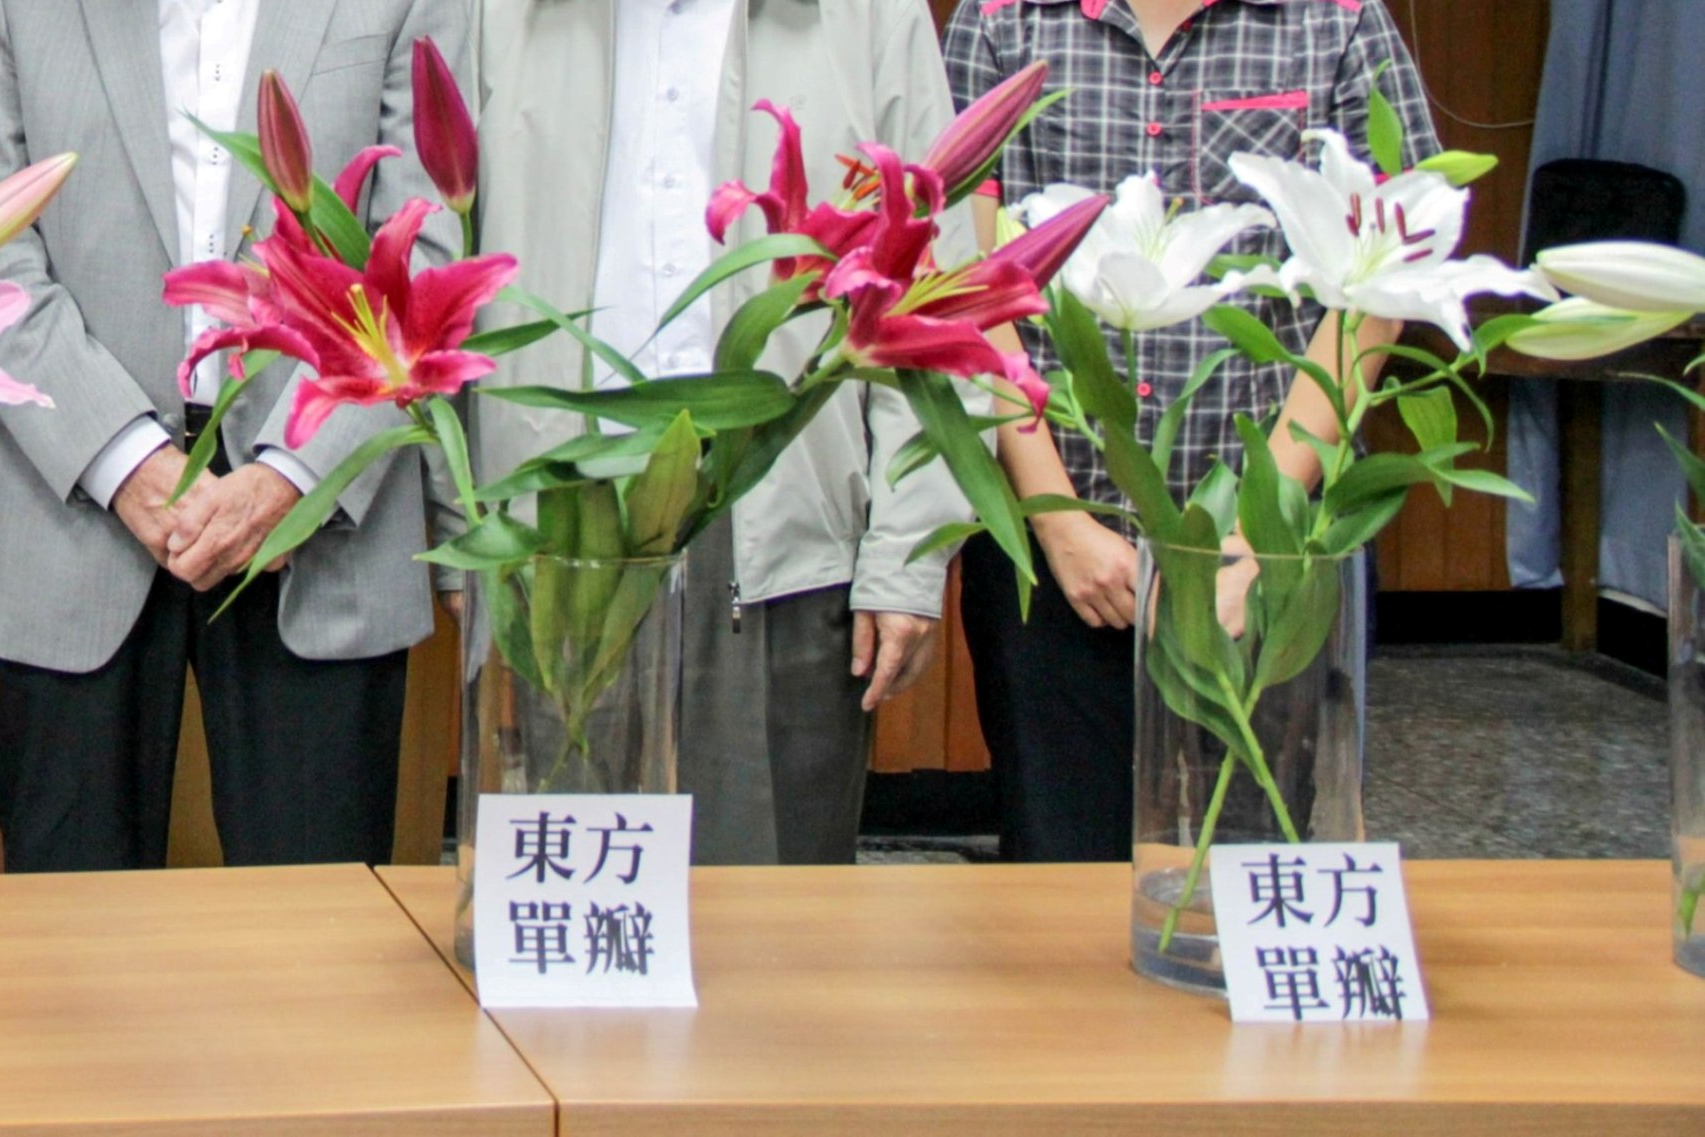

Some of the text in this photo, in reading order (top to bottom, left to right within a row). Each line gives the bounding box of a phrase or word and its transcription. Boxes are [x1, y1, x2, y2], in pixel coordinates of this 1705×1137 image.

[505, 811, 654, 884] 東方
[1241, 852, 1383, 928] 東方
[507, 900, 655, 976] 單瓣
[1255, 944, 1407, 1021] 單瓣
